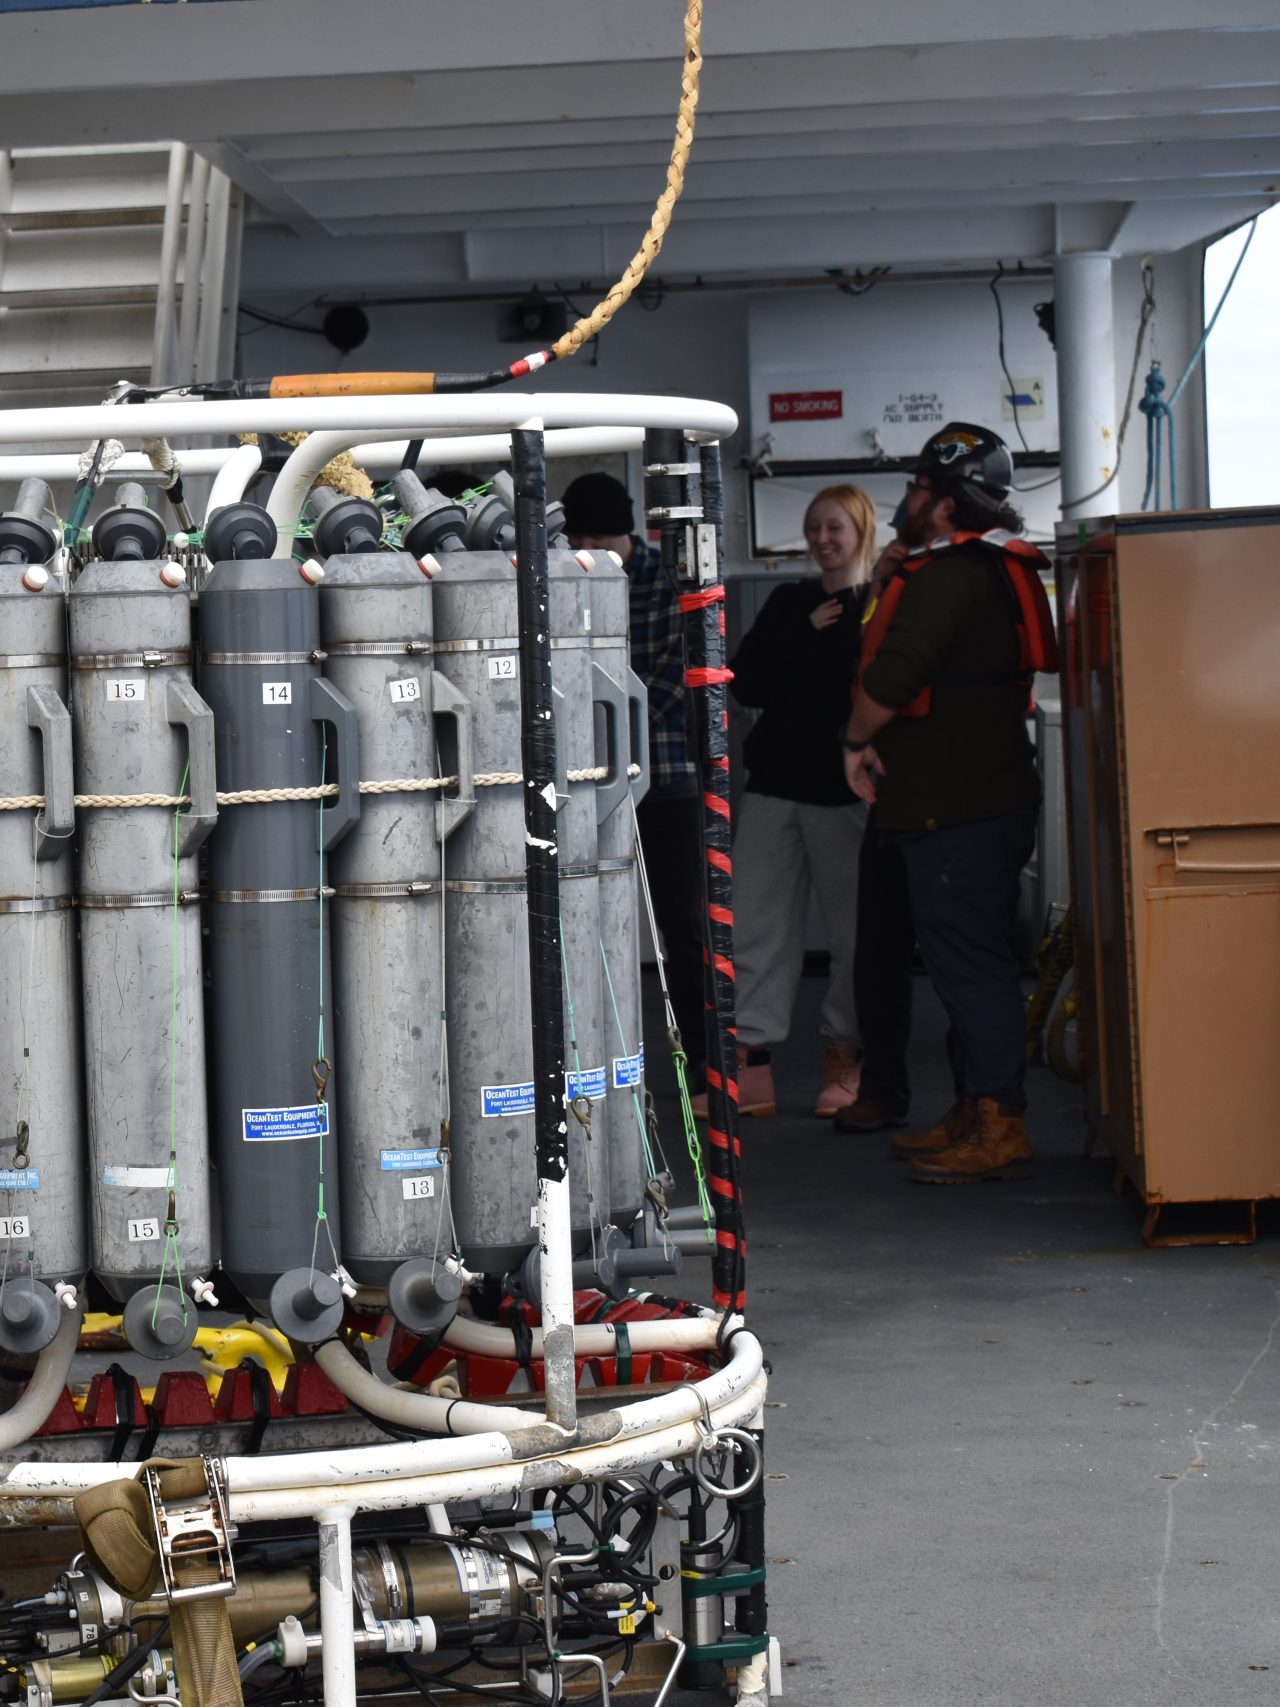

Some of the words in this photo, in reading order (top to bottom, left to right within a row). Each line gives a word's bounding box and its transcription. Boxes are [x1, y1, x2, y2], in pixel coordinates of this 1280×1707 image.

[774, 401, 790, 414] NO
[792, 399, 839, 413] SMOKING
[903, 402, 943, 413] SUPPLY
[495, 660, 512, 676] 12
[114, 683, 136, 698] 15
[268, 685, 289, 701] 14
[397, 682, 416, 698] 13
[411, 1180, 430, 1196] 13
[3, 1220, 24, 1235] 16
[132, 1223, 154, 1238] 15
